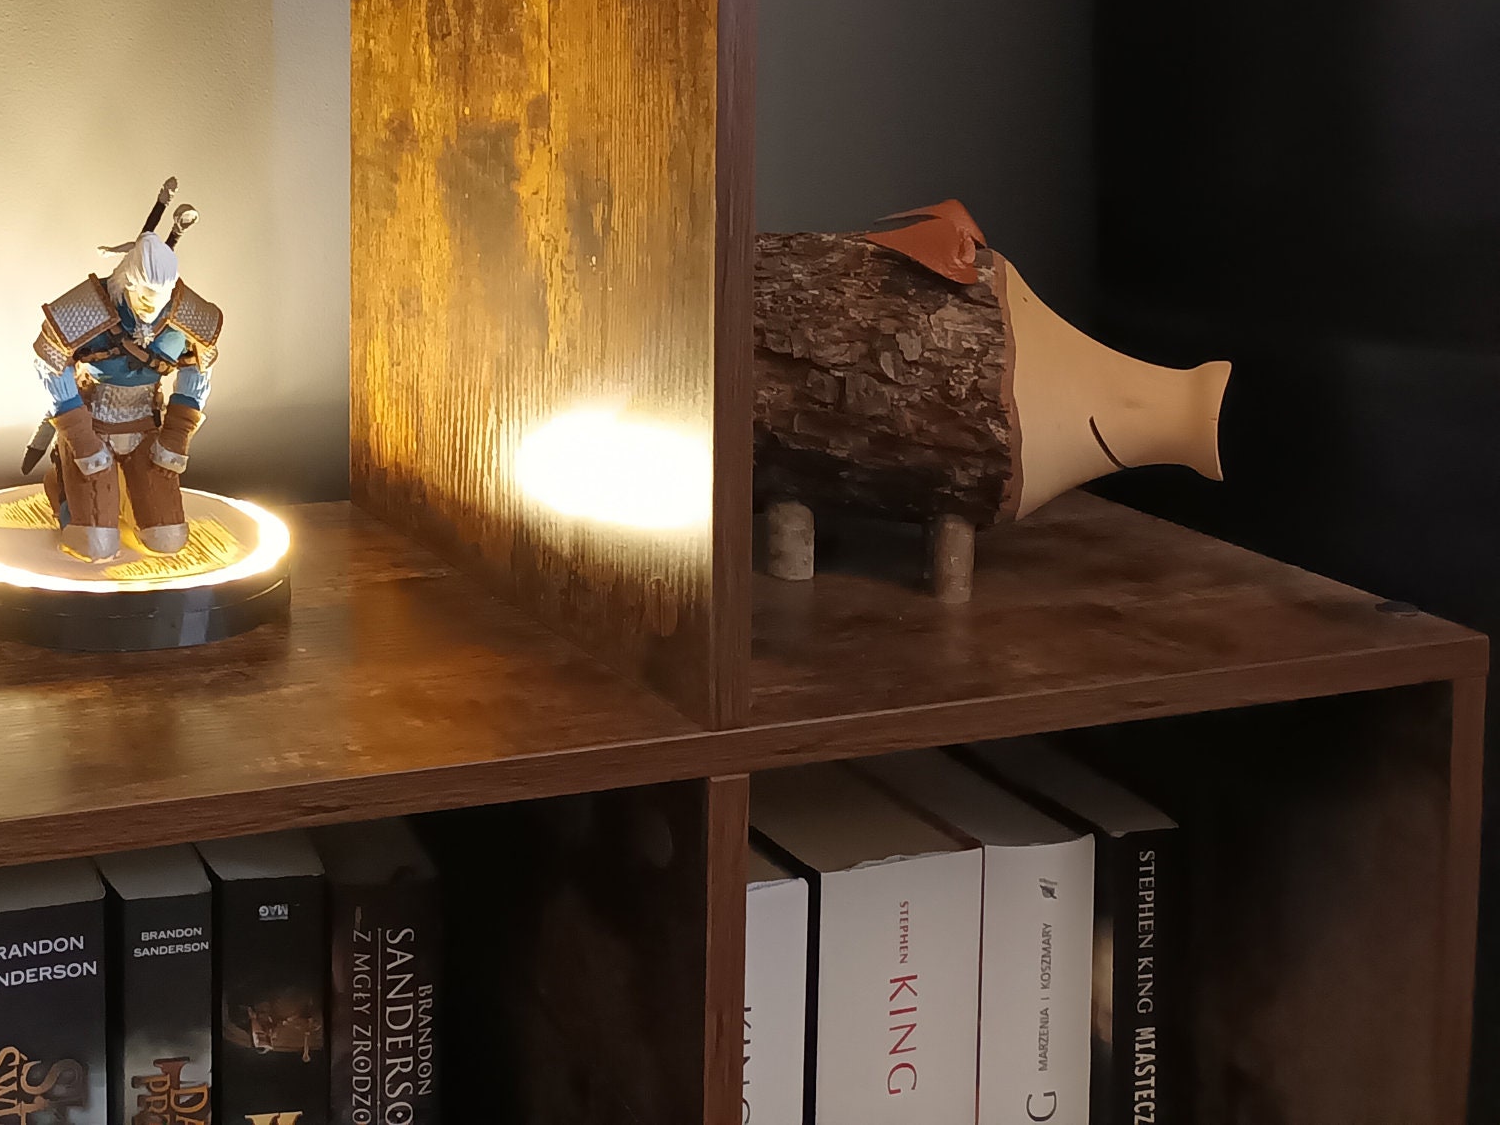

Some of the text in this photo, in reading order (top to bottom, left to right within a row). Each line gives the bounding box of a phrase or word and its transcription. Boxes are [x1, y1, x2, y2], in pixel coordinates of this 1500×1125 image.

[133, 941, 209, 958] SANDERSON
[141, 927, 203, 942] BRANDON
[353, 930, 371, 943] Z
[1040, 923, 1052, 992] KOSZMARY
[1136, 850, 1156, 1015] STEPHEN KING
[353, 953, 371, 1015] MGŁY
[887, 901, 918, 1096] STEPHEN KING
[384, 928, 415, 1125] SANDERSO
[417, 983, 433, 1096] BRANDON
[1038, 1007, 1049, 1072] MARZENIA
[1132, 1026, 1157, 1125] MIASTECZ
